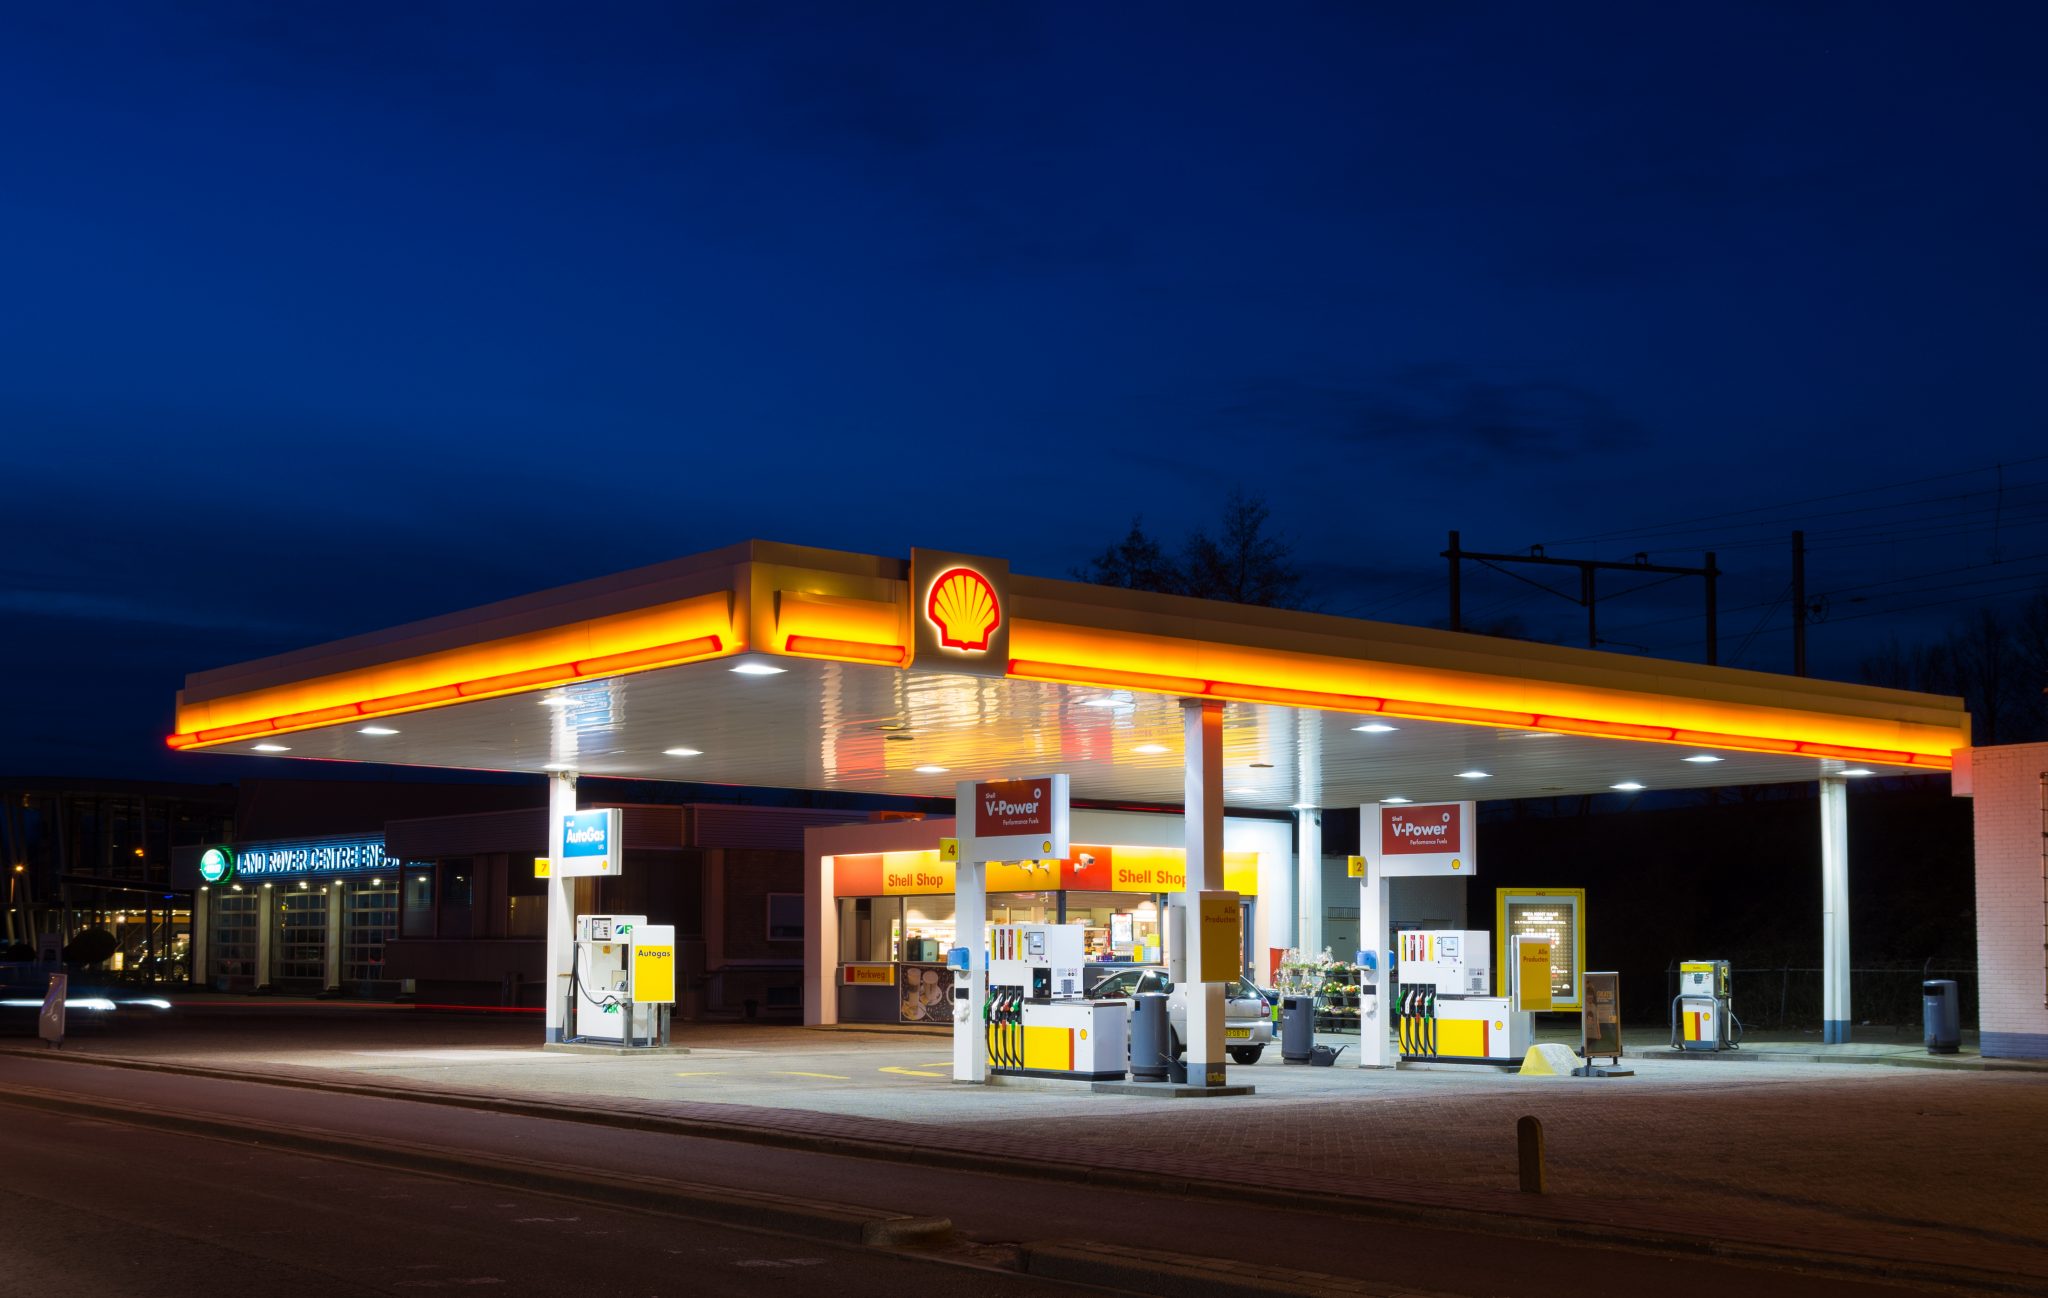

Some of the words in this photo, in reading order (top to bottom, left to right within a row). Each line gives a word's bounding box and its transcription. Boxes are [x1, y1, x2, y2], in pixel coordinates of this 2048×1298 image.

[985, 800, 1039, 816] V-Power
[566, 827, 605, 844] AutoGas
[1391, 823, 1448, 837] V-Power
[1436, 837, 1448, 845] Fuels
[948, 844, 956, 855] 4
[237, 853, 266, 874] LAND
[269, 850, 307, 872] ROVER
[310, 846, 359, 870] CENTRE
[541, 863, 548, 873] 7
[1356, 862, 1362, 872] 2
[888, 874, 913, 887] Shell
[916, 872, 943, 888] Shop
[1118, 869, 1151, 884] Shell
[638, 950, 671, 959] Autogas
[1522, 955, 1549, 963] Producten
